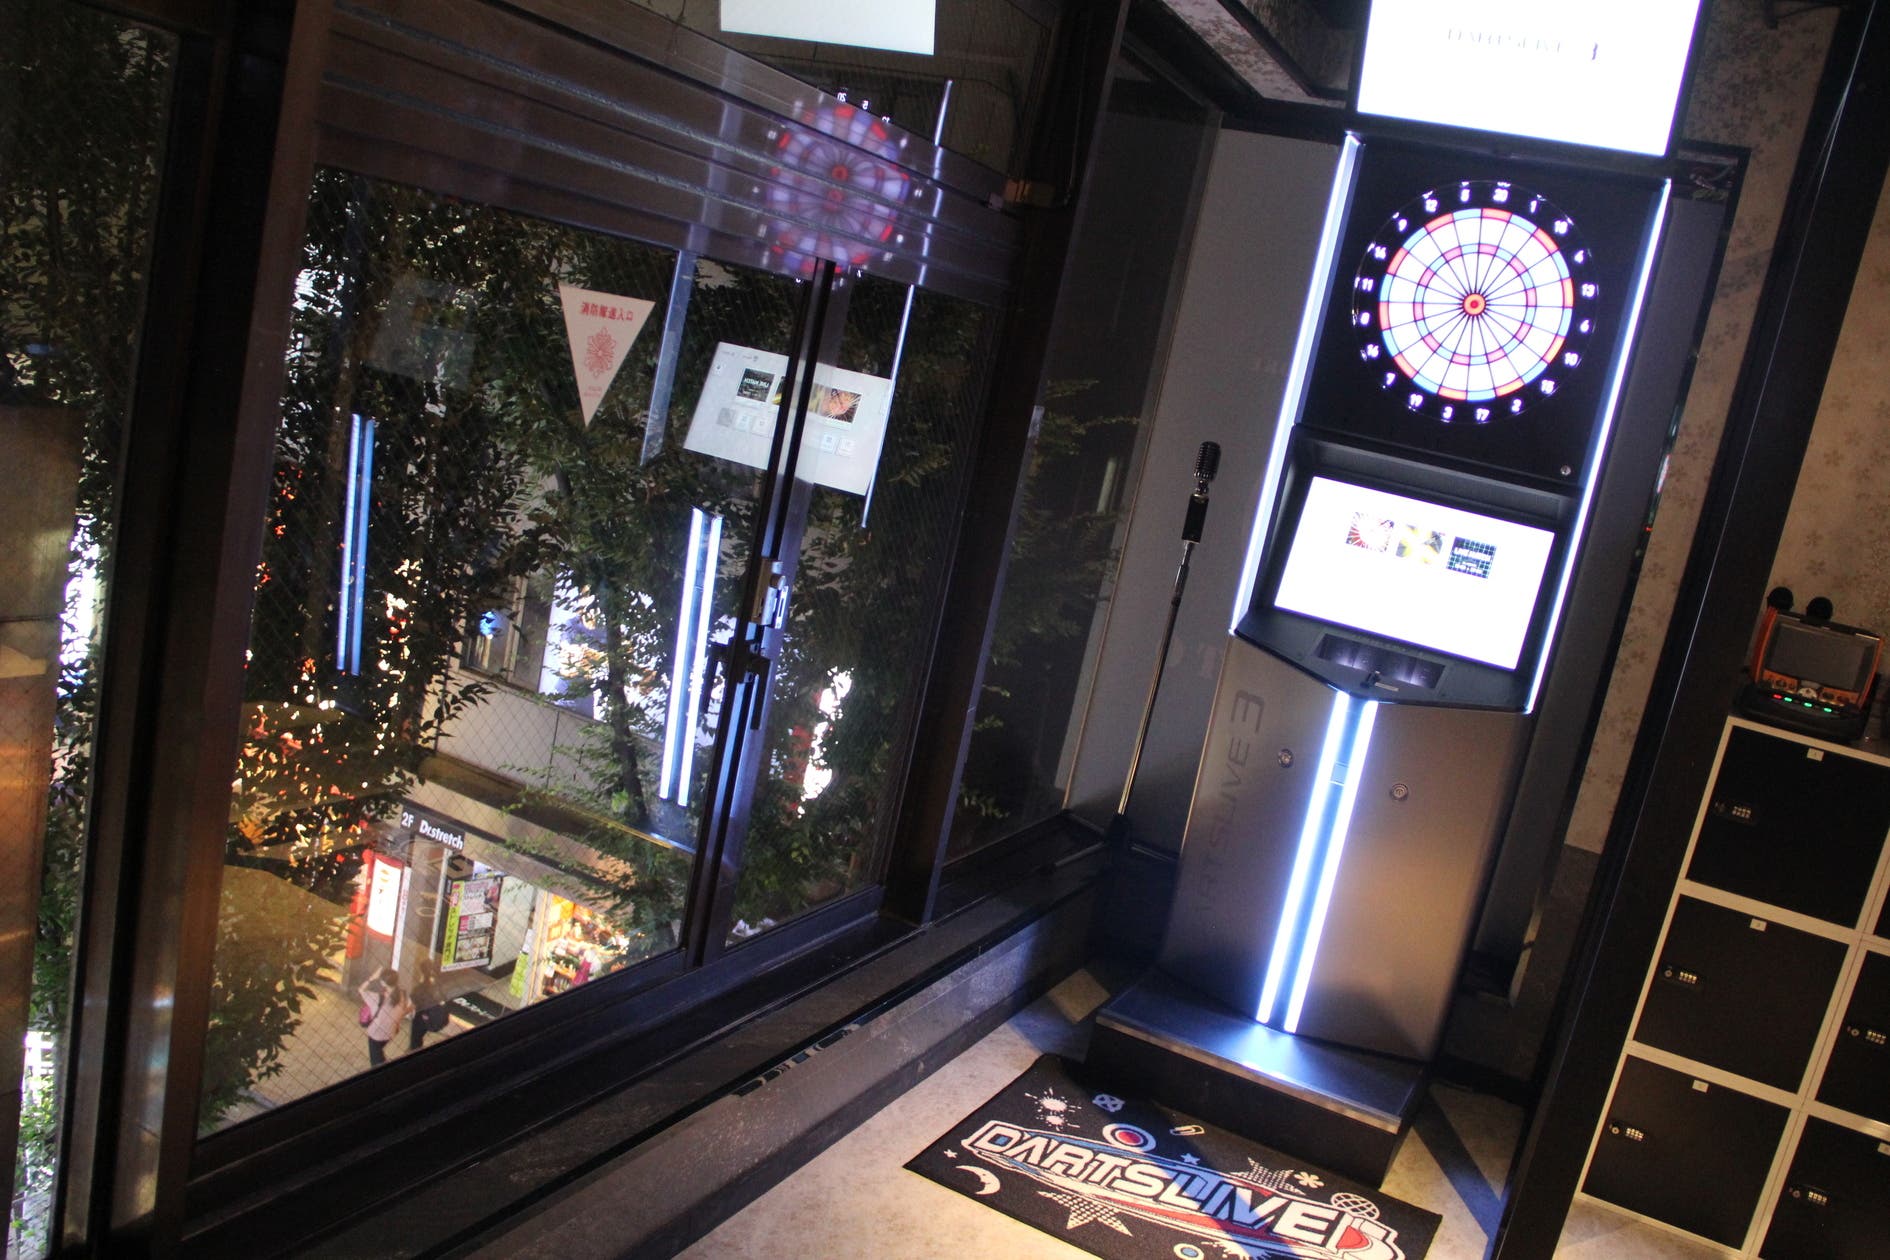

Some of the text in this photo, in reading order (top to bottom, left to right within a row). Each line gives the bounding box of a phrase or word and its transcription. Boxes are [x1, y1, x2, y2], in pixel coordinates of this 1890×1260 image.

[1492, 188, 1509, 202] 20
[1530, 200, 1538, 213] 1
[1361, 277, 1374, 292] 11
[1581, 283, 1596, 298] 13
[1579, 319, 1590, 333] 6
[1386, 372, 1396, 386] 7
[1409, 393, 1424, 407] 19
[1511, 398, 1522, 413] 2
[1442, 406, 1453, 419] 3
[1475, 407, 1490, 421] 17
[401, 811, 414, 828] 2F
[974, 1122, 1340, 1249] DARTSLIVE
